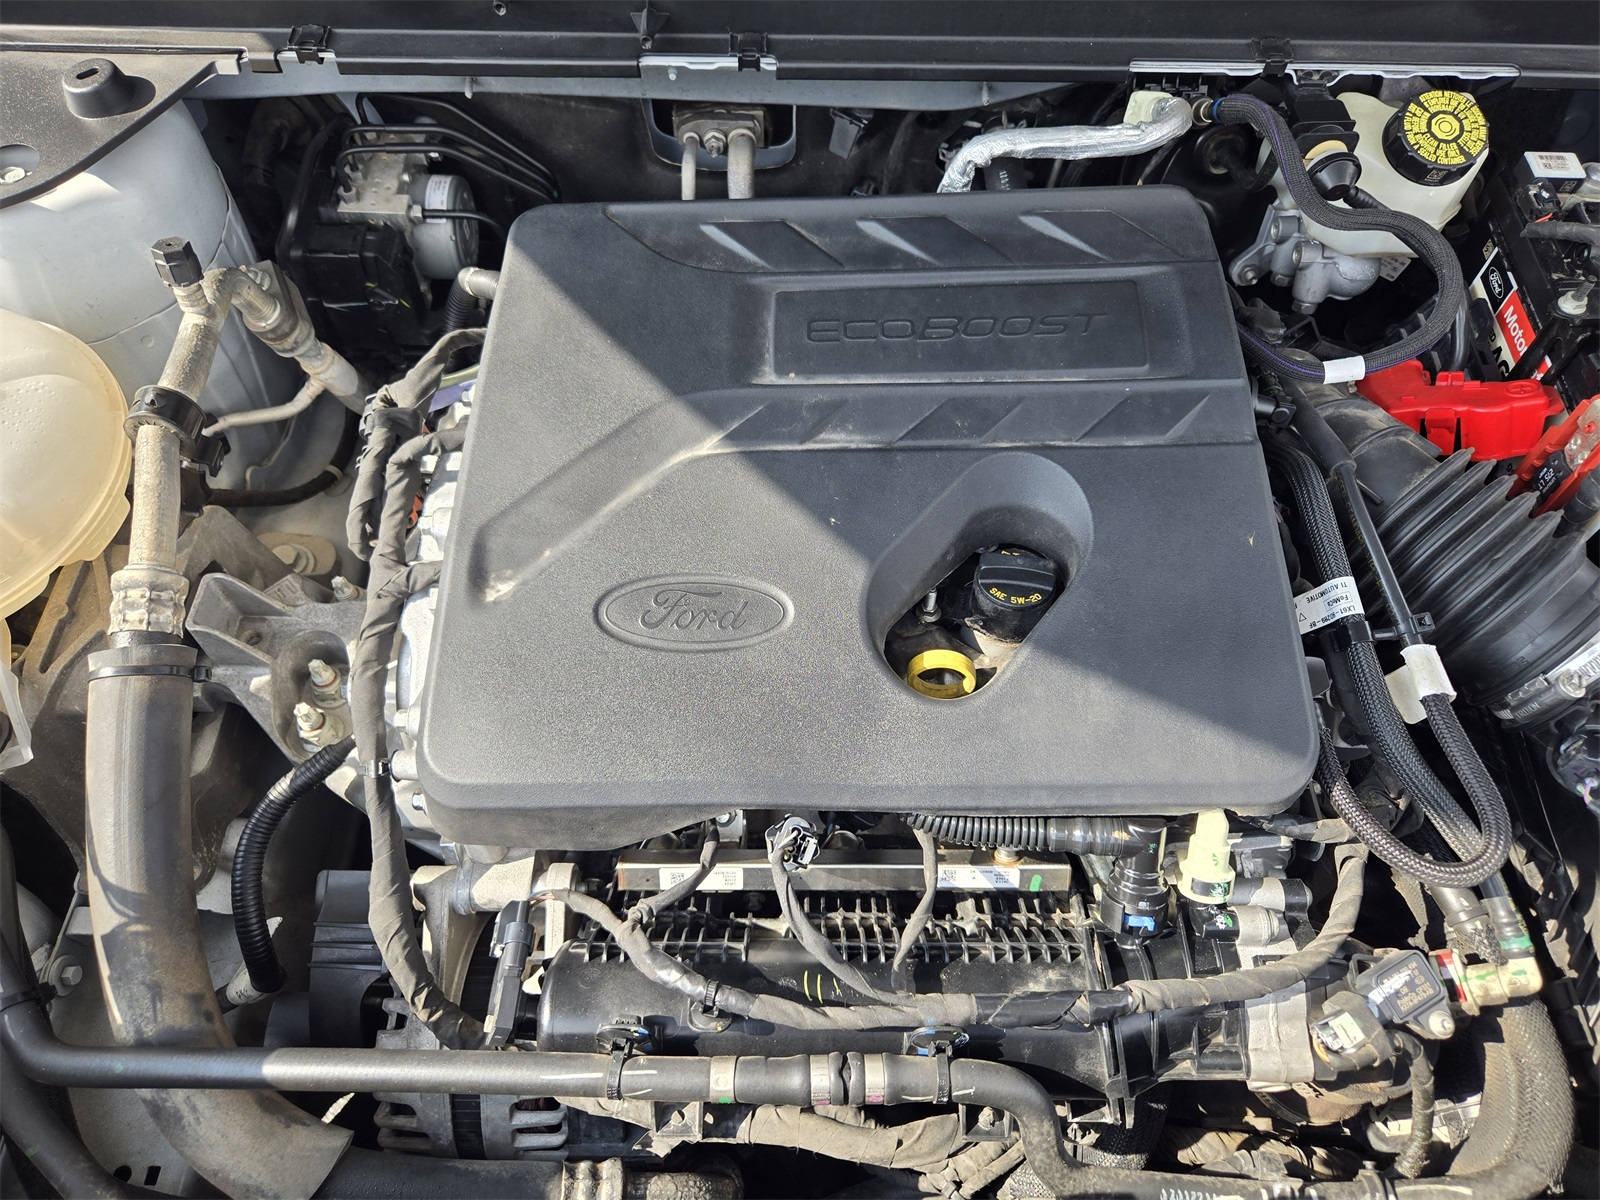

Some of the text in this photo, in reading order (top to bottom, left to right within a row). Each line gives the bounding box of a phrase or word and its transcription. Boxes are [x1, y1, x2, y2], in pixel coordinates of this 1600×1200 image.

[1444, 91, 1467, 103] NETTOYER
[1406, 132, 1416, 145] FROM
[1418, 148, 1436, 162] SEALED
[1437, 155, 1466, 164] CONTAINER
[1415, 133, 1436, 153] REMOVING
[1436, 149, 1447, 157] USE
[1448, 149, 1460, 157] ONLY
[1423, 134, 1439, 146] CLEAN
[806, 312, 1108, 343] ECOBOOST
[1544, 468, 1554, 482] 275
[989, 587, 1042, 604] SAE 5W-20
[1306, 583, 1339, 603] AUTOMOTIVE
[1327, 594, 1349, 607] FoMoCo
[638, 588, 749, 631] Ford
